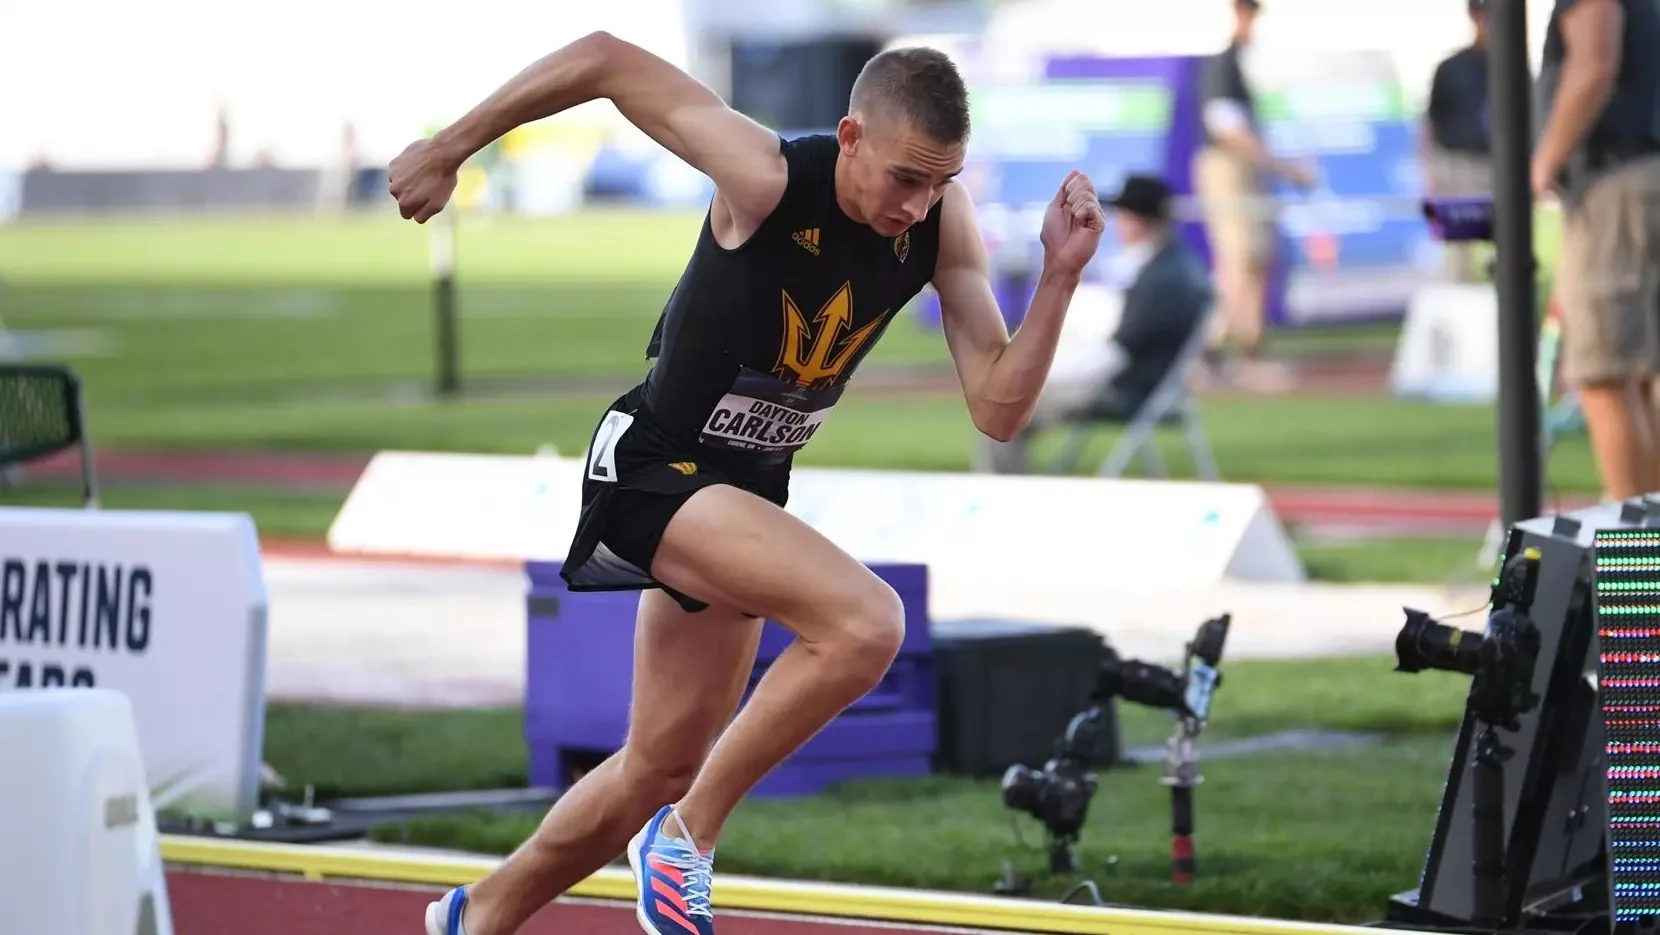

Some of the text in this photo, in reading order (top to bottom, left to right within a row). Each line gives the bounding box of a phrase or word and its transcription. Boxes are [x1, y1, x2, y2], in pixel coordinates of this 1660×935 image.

[791, 231, 821, 256] adidas
[708, 408, 822, 444] CARLSON
[748, 400, 810, 426] DAYTON
[592, 414, 620, 478] 2
[0, 559, 153, 653] RATING
